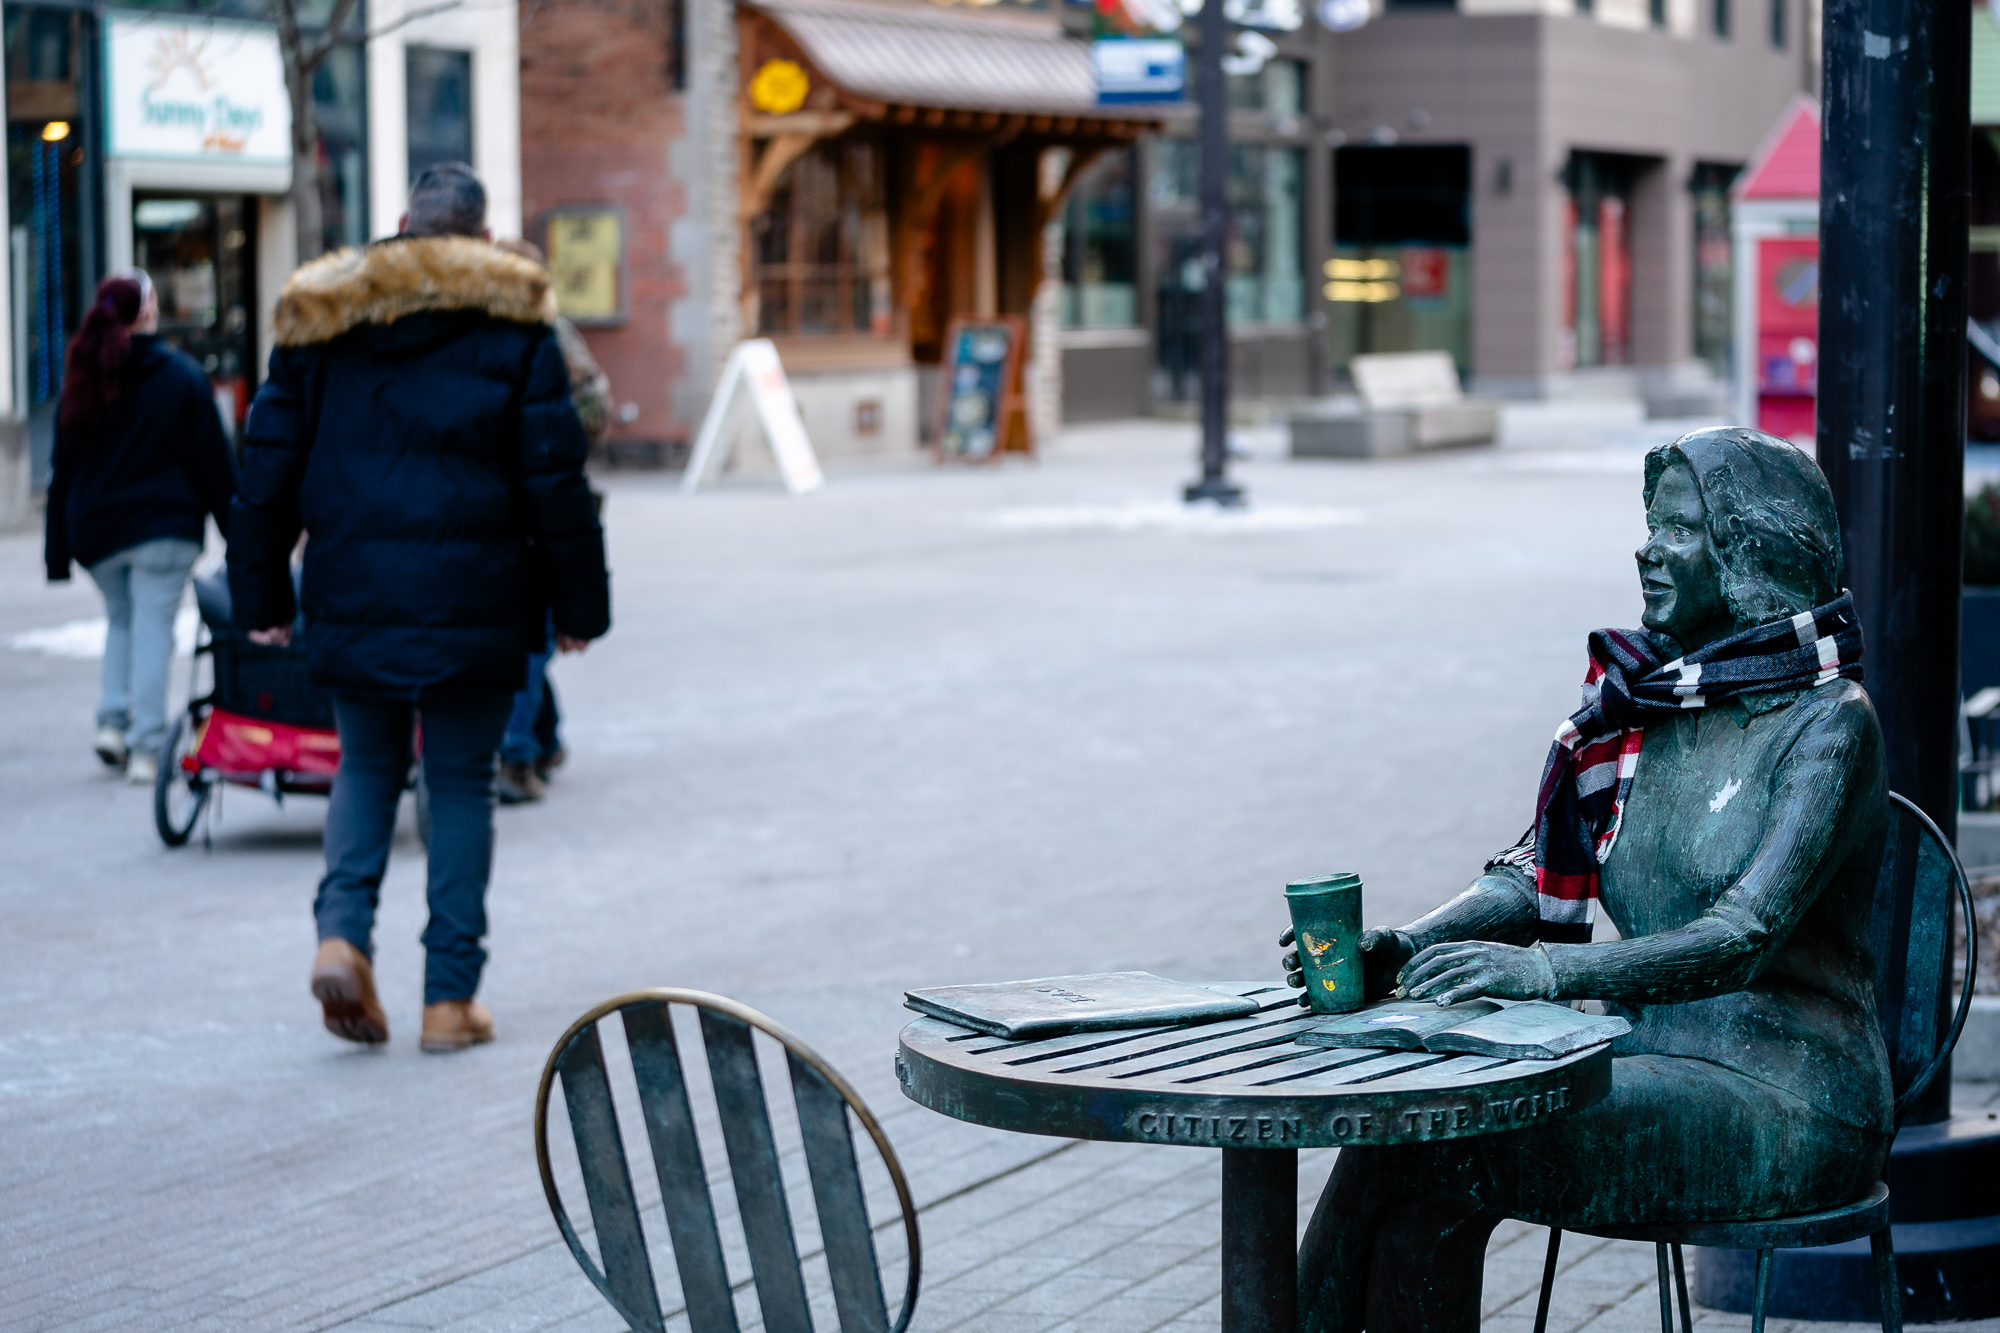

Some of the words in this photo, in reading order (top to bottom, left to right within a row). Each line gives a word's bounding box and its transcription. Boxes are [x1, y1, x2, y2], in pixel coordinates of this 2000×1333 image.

[141, 86, 206, 135] Sunny
[1138, 1112, 1301, 1141] CITIZEN
[1332, 1113, 1372, 1139] OF
[1403, 1106, 1470, 1132] THE
